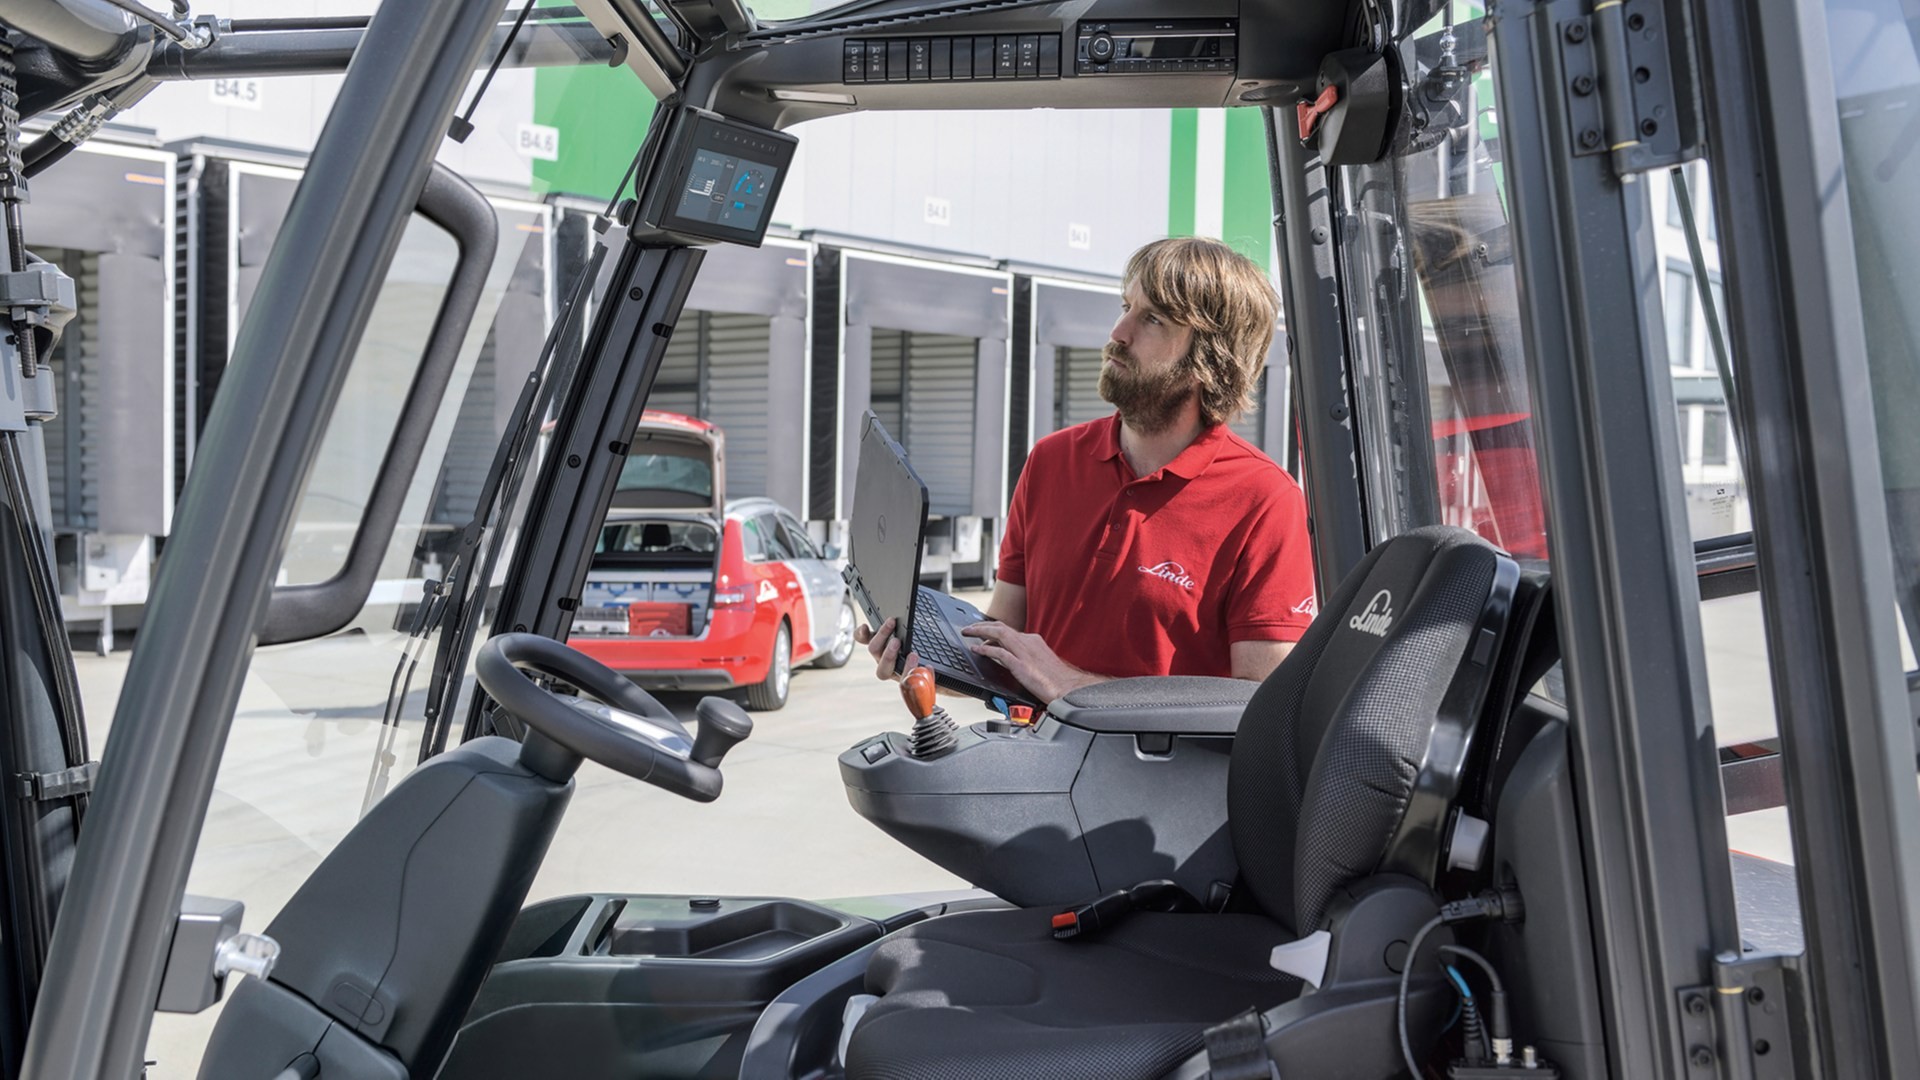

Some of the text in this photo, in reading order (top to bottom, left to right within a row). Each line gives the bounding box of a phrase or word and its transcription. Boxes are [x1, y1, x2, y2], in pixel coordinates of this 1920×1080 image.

[214, 79, 257, 101] B4.5
[1137, 561, 1195, 588] Linde
[1349, 589, 1393, 637] Linde
